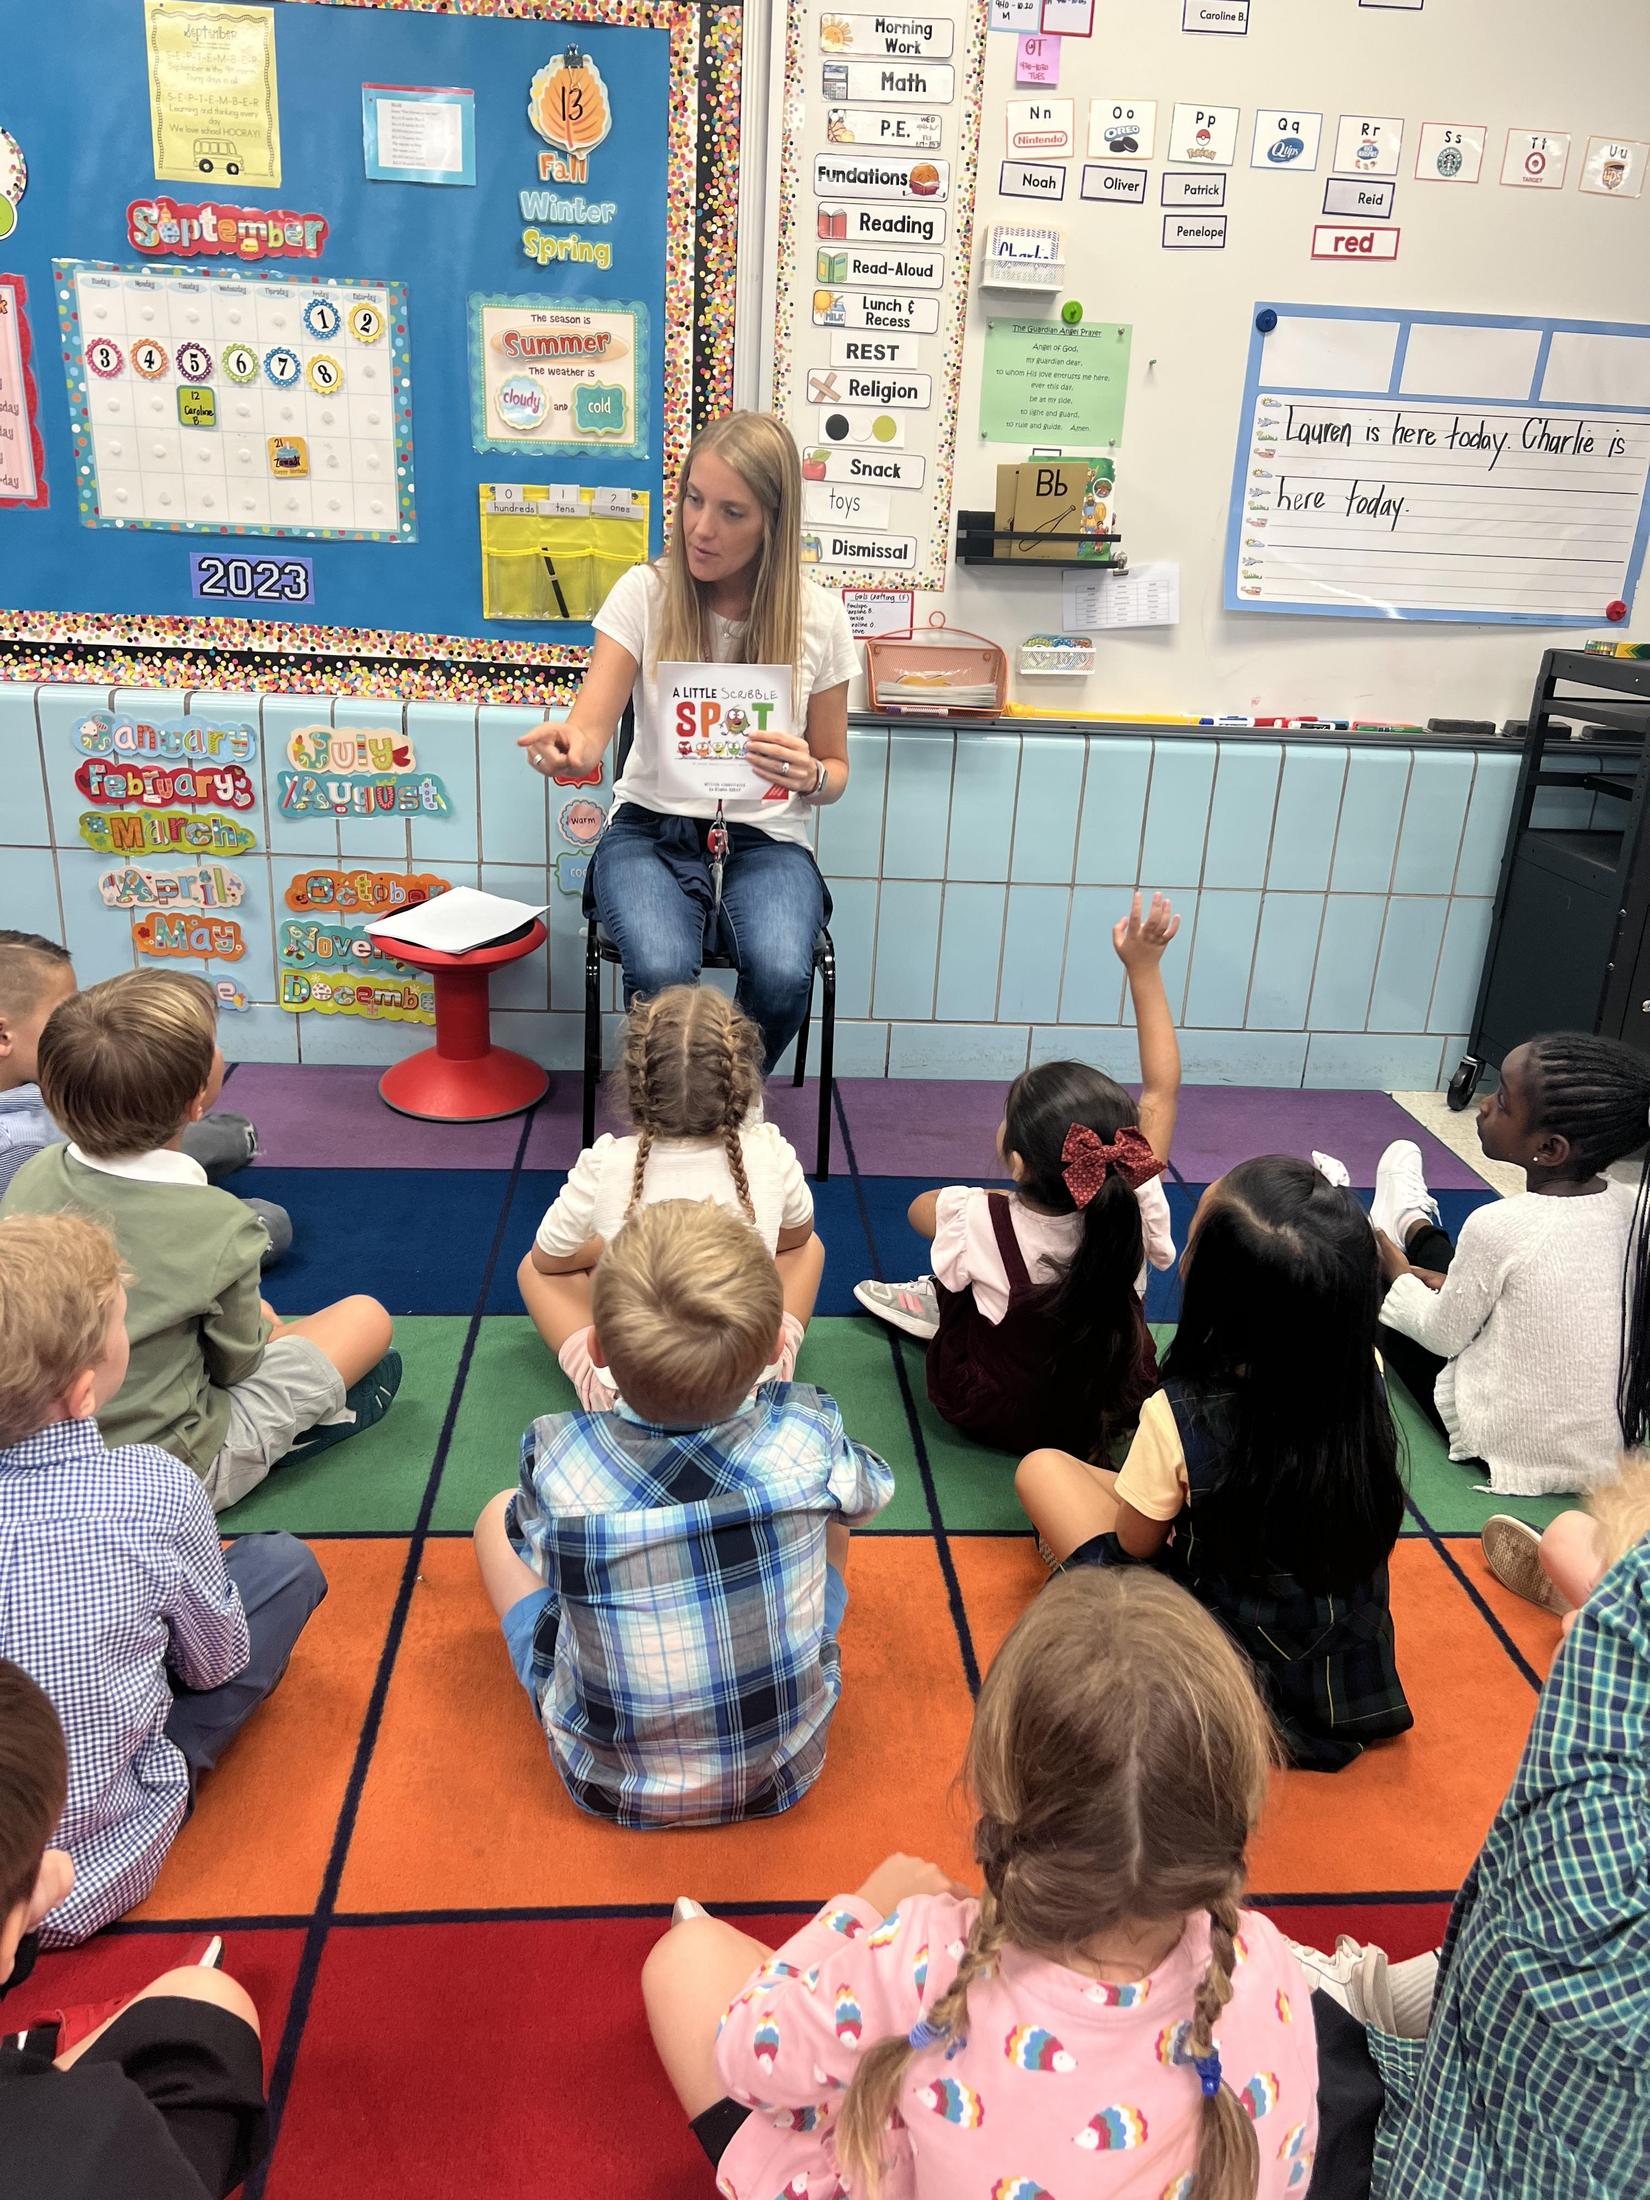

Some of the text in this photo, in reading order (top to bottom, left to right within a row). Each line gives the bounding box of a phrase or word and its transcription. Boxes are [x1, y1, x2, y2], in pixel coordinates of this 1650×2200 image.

[1199, 9, 1247, 22] Caroline B.
[875, 18, 933, 40] Morning
[885, 37, 921, 54] Work
[1025, 38, 1047, 56] OT
[881, 71, 927, 93] Math
[561, 86, 584, 121] 13
[1030, 106, 1052, 119] N n
[1112, 106, 1134, 119] O o
[169, 123, 184, 132] We
[880, 119, 911, 138] P.E.
[1195, 111, 1216, 128] P p
[1278, 117, 1300, 134] Q q
[1104, 125, 1140, 140] OREO
[1361, 123, 1381, 136] R r
[1444, 130, 1462, 144] S s
[1018, 135, 1064, 145] Nintendo
[1531, 137, 1547, 150] T t
[1609, 145, 1628, 159] U u
[538, 152, 589, 183] Fall
[818, 165, 908, 187] Fundations
[1022, 174, 1057, 189] Noah
[1103, 177, 1140, 192] Oliver
[1184, 184, 1220, 196] Patrick
[521, 191, 616, 223] Winter
[1358, 192, 1384, 206] Reid
[132, 204, 325, 250] September
[859, 212, 934, 240] Reading
[1176, 225, 1224, 240] Penelope
[522, 227, 612, 270] Spring
[1333, 232, 1375, 253] red
[853, 259, 934, 278] Read-Aloud
[862, 295, 902, 313] Lunch
[315, 309, 329, 329] 1
[360, 313, 373, 333] 2
[531, 314, 591, 325] The season is
[824, 311, 845, 323] MILK
[865, 311, 911, 328] Recess
[1012, 324, 1102, 337] The Guardian Angel Prayer
[503, 331, 611, 358] Summer
[846, 342, 900, 361] REST
[1053, 344, 1062, 352] of
[99, 349, 111, 368] 3
[143, 349, 156, 369] 4
[189, 353, 200, 373] 5
[236, 353, 247, 374] 6
[277, 356, 289, 376] 7
[319, 364, 332, 384] 8
[528, 366, 595, 378] The weather is
[191, 391, 201, 400] 12
[502, 387, 542, 414] cloudy
[848, 379, 918, 404] Religion
[184, 405, 215, 417] Caroline
[553, 402, 569, 412] and
[587, 395, 612, 414] cold
[274, 438, 284, 448] 21
[1284, 404, 1626, 472] Lauren is here today. Charlie is
[849, 458, 902, 479] Snack
[1035, 468, 1069, 497] Bb
[493, 502, 536, 514] hundreds
[555, 503, 576, 514] tens
[610, 505, 631, 514] ones
[829, 487, 861, 519] toys
[1277, 475, 1411, 532] here today.
[831, 538, 908, 560] Dismissal
[198, 556, 309, 602] 2023
[672, 687, 680, 698] A
[683, 687, 717, 699] LITTLE
[297, 731, 393, 770] July
[88, 764, 235, 804] February
[294, 775, 439, 813] August
[570, 816, 596, 825] warm
[109, 816, 238, 848] March
[116, 867, 228, 905] April
[155, 917, 235, 954] May
